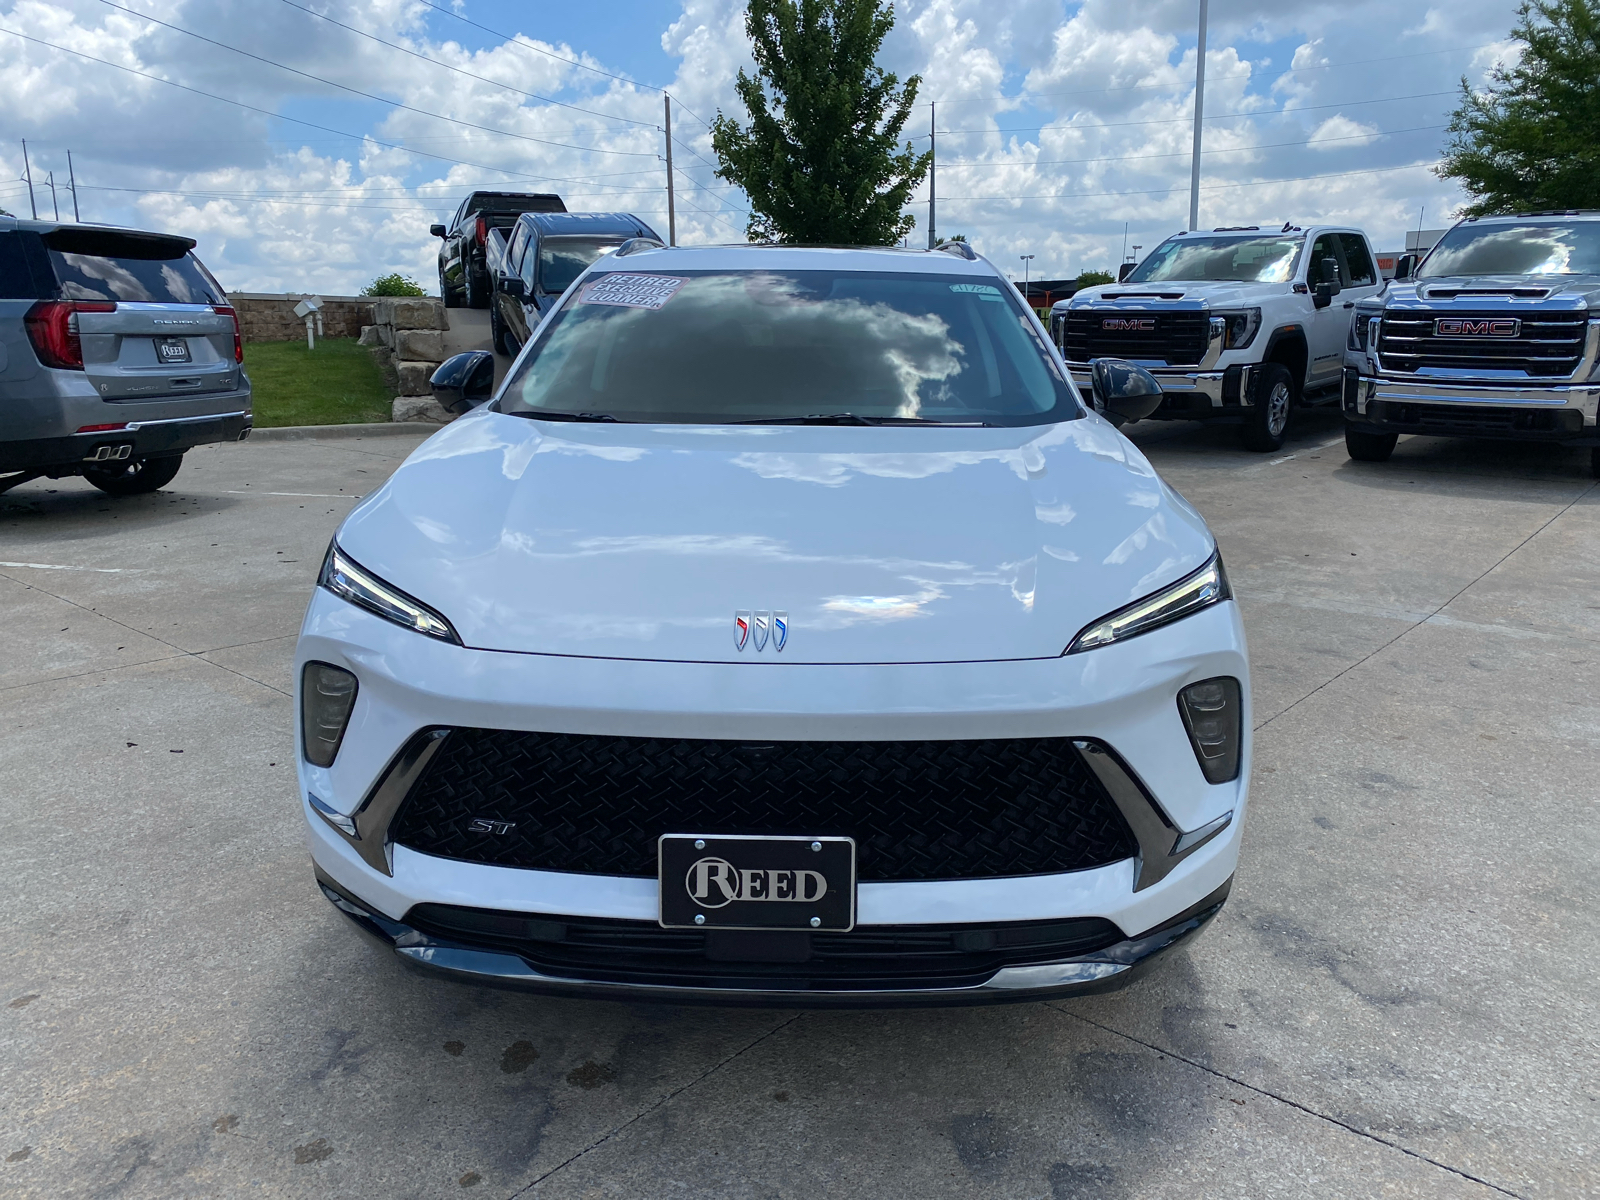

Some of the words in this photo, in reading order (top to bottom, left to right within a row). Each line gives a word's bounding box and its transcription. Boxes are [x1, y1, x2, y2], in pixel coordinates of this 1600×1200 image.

[603, 274, 682, 288] RETIRED
[591, 283, 675, 297] EXECUTIVE
[587, 292, 660, 306] LOANER
[1102, 318, 1156, 330] GMC
[1439, 320, 1515, 334] GMC
[161, 344, 185, 357] REED
[467, 818, 517, 835] ST
[690, 860, 828, 903] REED
